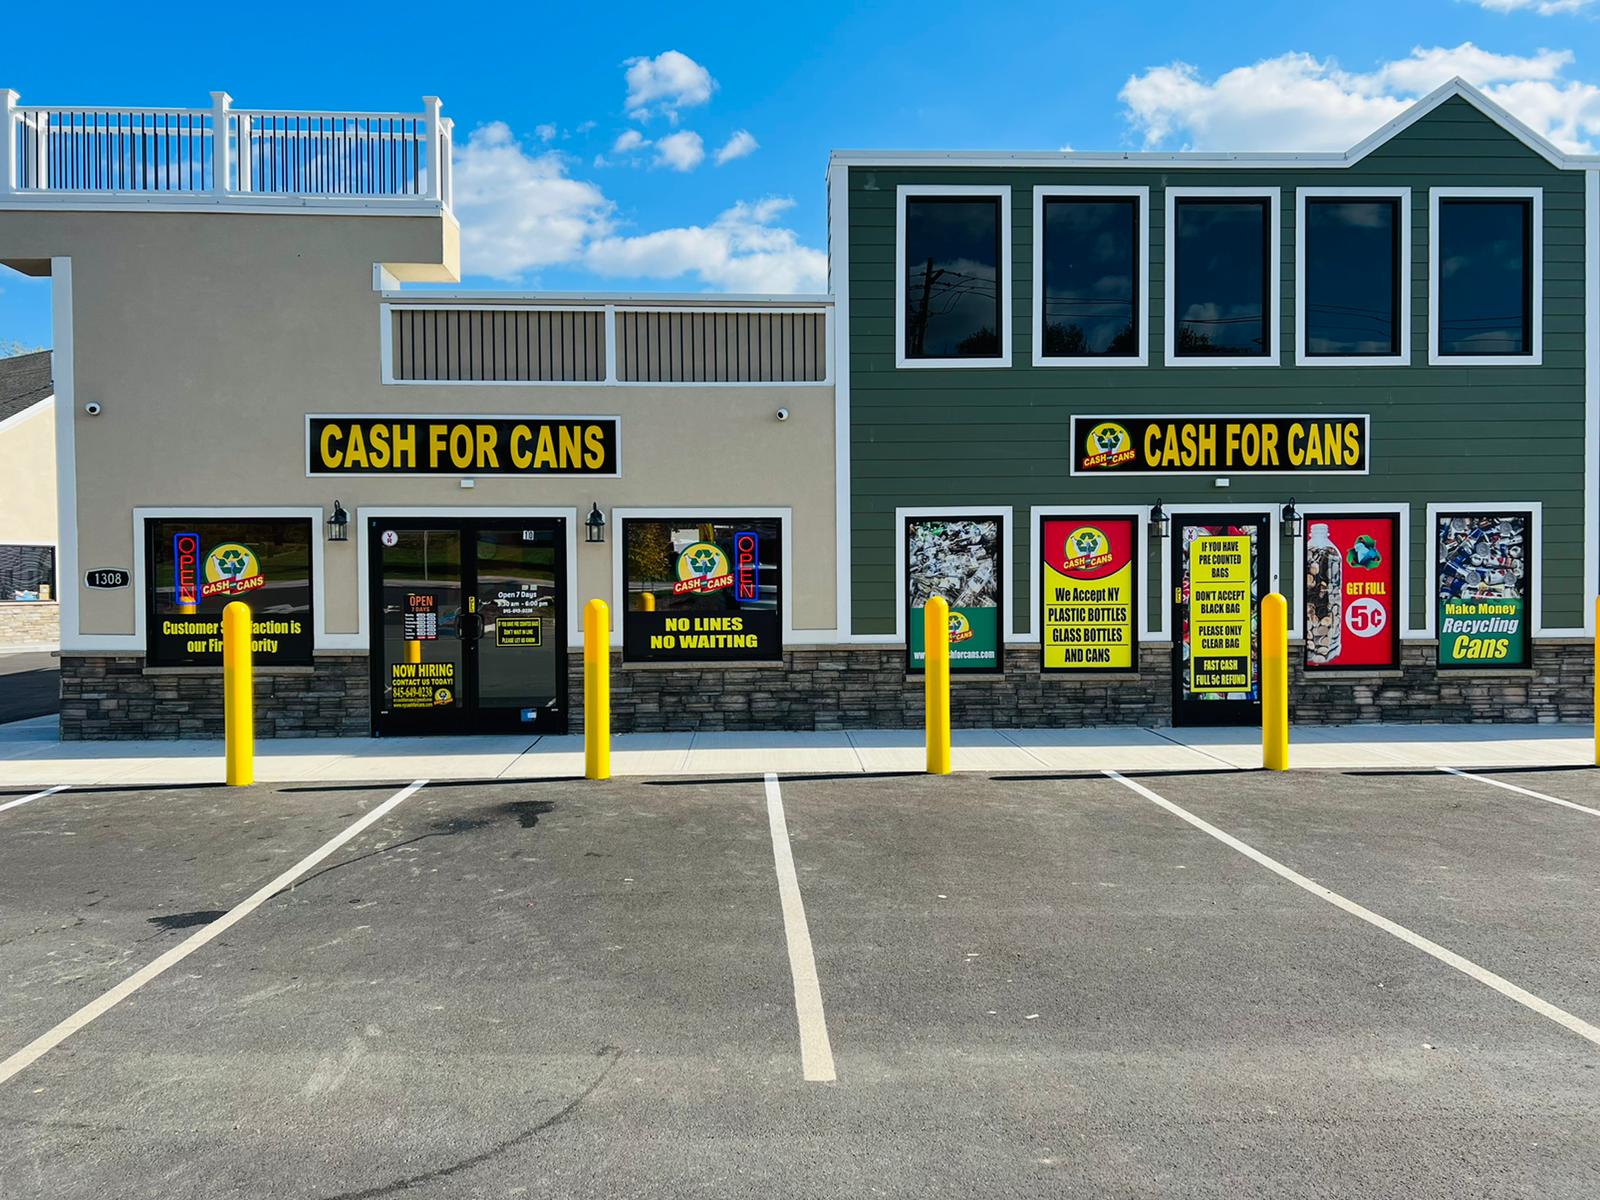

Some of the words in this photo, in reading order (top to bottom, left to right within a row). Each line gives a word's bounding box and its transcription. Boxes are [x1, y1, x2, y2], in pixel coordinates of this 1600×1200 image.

[320, 424, 416, 469] CASH
[429, 424, 499, 469] FOR
[510, 424, 605, 469] CANS
[1144, 423, 1217, 467] CASH
[1226, 423, 1280, 466] FOR
[1287, 422, 1360, 466] CANS
[1083, 454, 1107, 466] CASH
[1112, 450, 1136, 464] CANS
[1201, 542, 1208, 551] IF
[1209, 542, 1221, 551] YOU
[1222, 541, 1239, 551] HAVE
[738, 536, 755, 598] OPEN
[1063, 557, 1086, 569] CASH
[1090, 553, 1113, 566] CANS
[1199, 555, 1211, 565] PRE
[1212, 554, 1241, 564] COUNTED
[178, 537, 197, 603] OPEN
[1211, 568, 1229, 578] BAGS
[95, 573, 122, 585] 1308
[202, 580, 230, 595] CASH
[236, 576, 264, 591] CANS
[674, 579, 701, 593] CASH
[707, 575, 734, 589] CANS
[1055, 587, 1071, 602] We
[1072, 587, 1106, 603] Accept
[1107, 587, 1120, 602] NY
[1195, 591, 1216, 601] DON'T
[1217, 590, 1245, 601] ACCEPT
[1346, 582, 1364, 595] GET
[1365, 581, 1386, 595] FULL
[409, 595, 433, 606] OPEN
[1048, 608, 1086, 622] PLASTIC
[1088, 607, 1127, 622] BOTTLES
[1201, 603, 1224, 614] BLACK
[1225, 603, 1240, 613] BAG
[1445, 603, 1476, 615] Make
[1478, 603, 1516, 615] Money
[665, 618, 690, 631] NO
[694, 617, 743, 631] LINES
[1351, 605, 1383, 631] 5¢
[1442, 617, 1519, 634] Recycling
[163, 621, 218, 635] Customer
[290, 620, 302, 634] is
[1052, 628, 1082, 642] GLASS
[1083, 628, 1122, 642] BOTTLES
[1199, 625, 1224, 636] PLEASE
[1225, 625, 1243, 636] ONLY
[187, 640, 206, 652] our
[208, 638, 224, 653] Fir
[650, 635, 675, 649] NO
[679, 634, 758, 648] WAITING
[1201, 638, 1223, 649] CLEAR
[1225, 638, 1240, 648] BAG
[1452, 635, 1509, 659] Cans
[1064, 648, 1084, 663] AND
[1085, 648, 1110, 662] CANS
[392, 664, 416, 678] NOW
[418, 663, 454, 677] HIRING
[1203, 660, 1219, 671] FAST
[1220, 659, 1238, 670] CASH
[1196, 674, 1211, 685] FULL
[1221, 674, 1246, 685] REFUND
[393, 687, 433, 697] 845-649-0238
